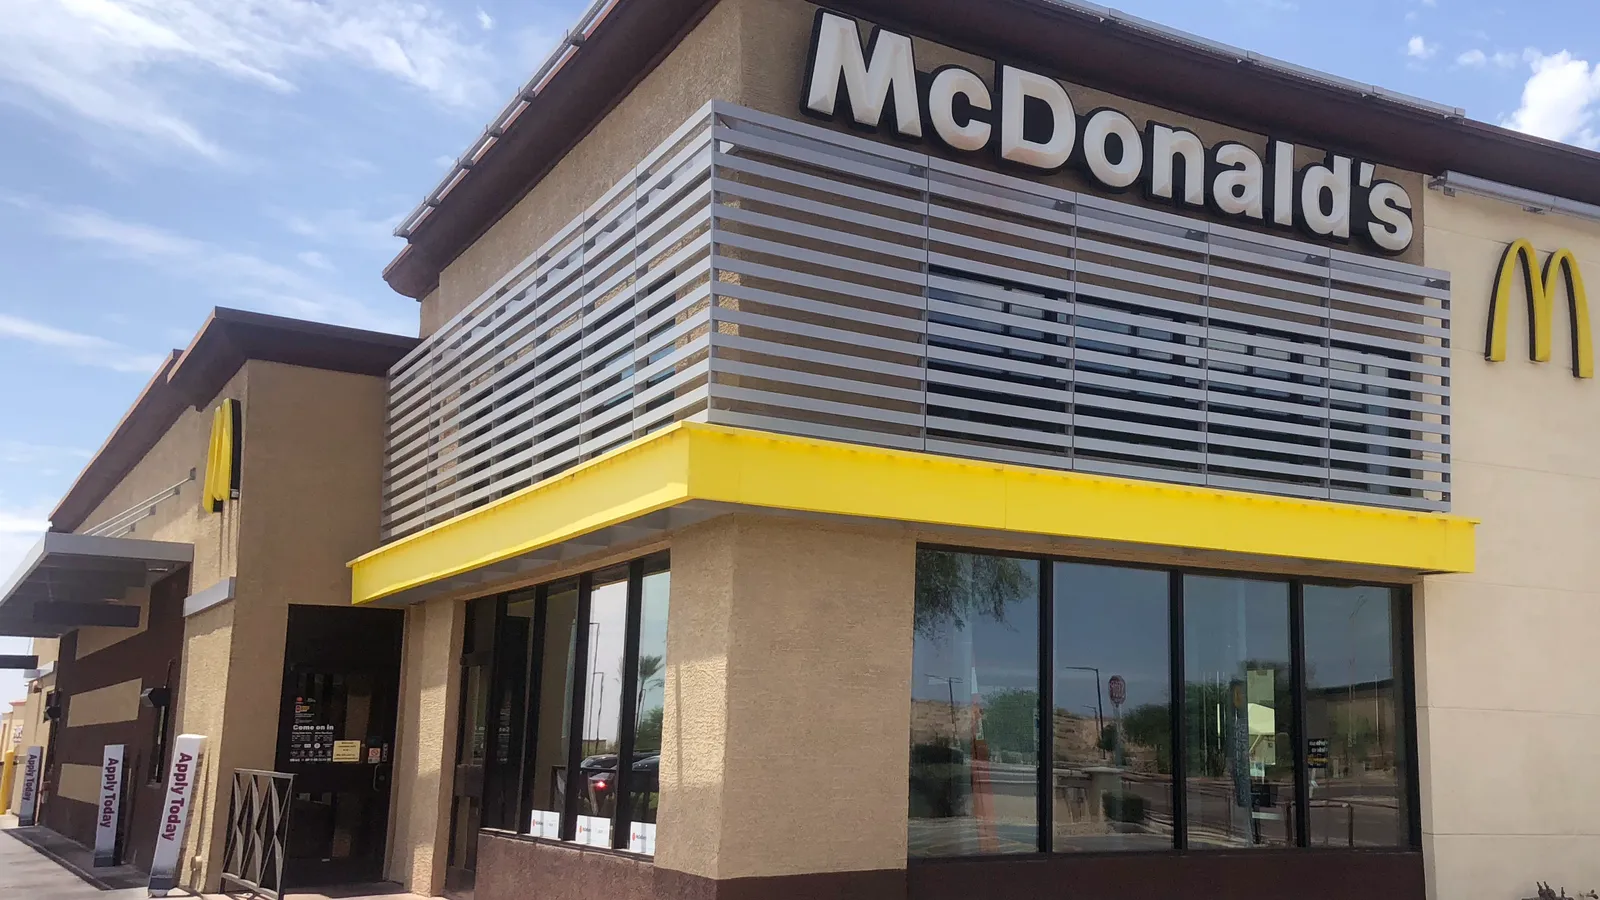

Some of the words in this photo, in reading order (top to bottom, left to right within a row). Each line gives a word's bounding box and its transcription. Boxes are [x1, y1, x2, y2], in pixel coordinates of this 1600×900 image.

[806, 11, 1413, 253] McDonald's
[26, 754, 37, 777] Apply
[104, 758, 119, 791] Apply
[170, 753, 193, 795] Apply
[22, 778, 35, 801] Today
[100, 793, 116, 828] Today
[162, 798, 184, 841] Today
